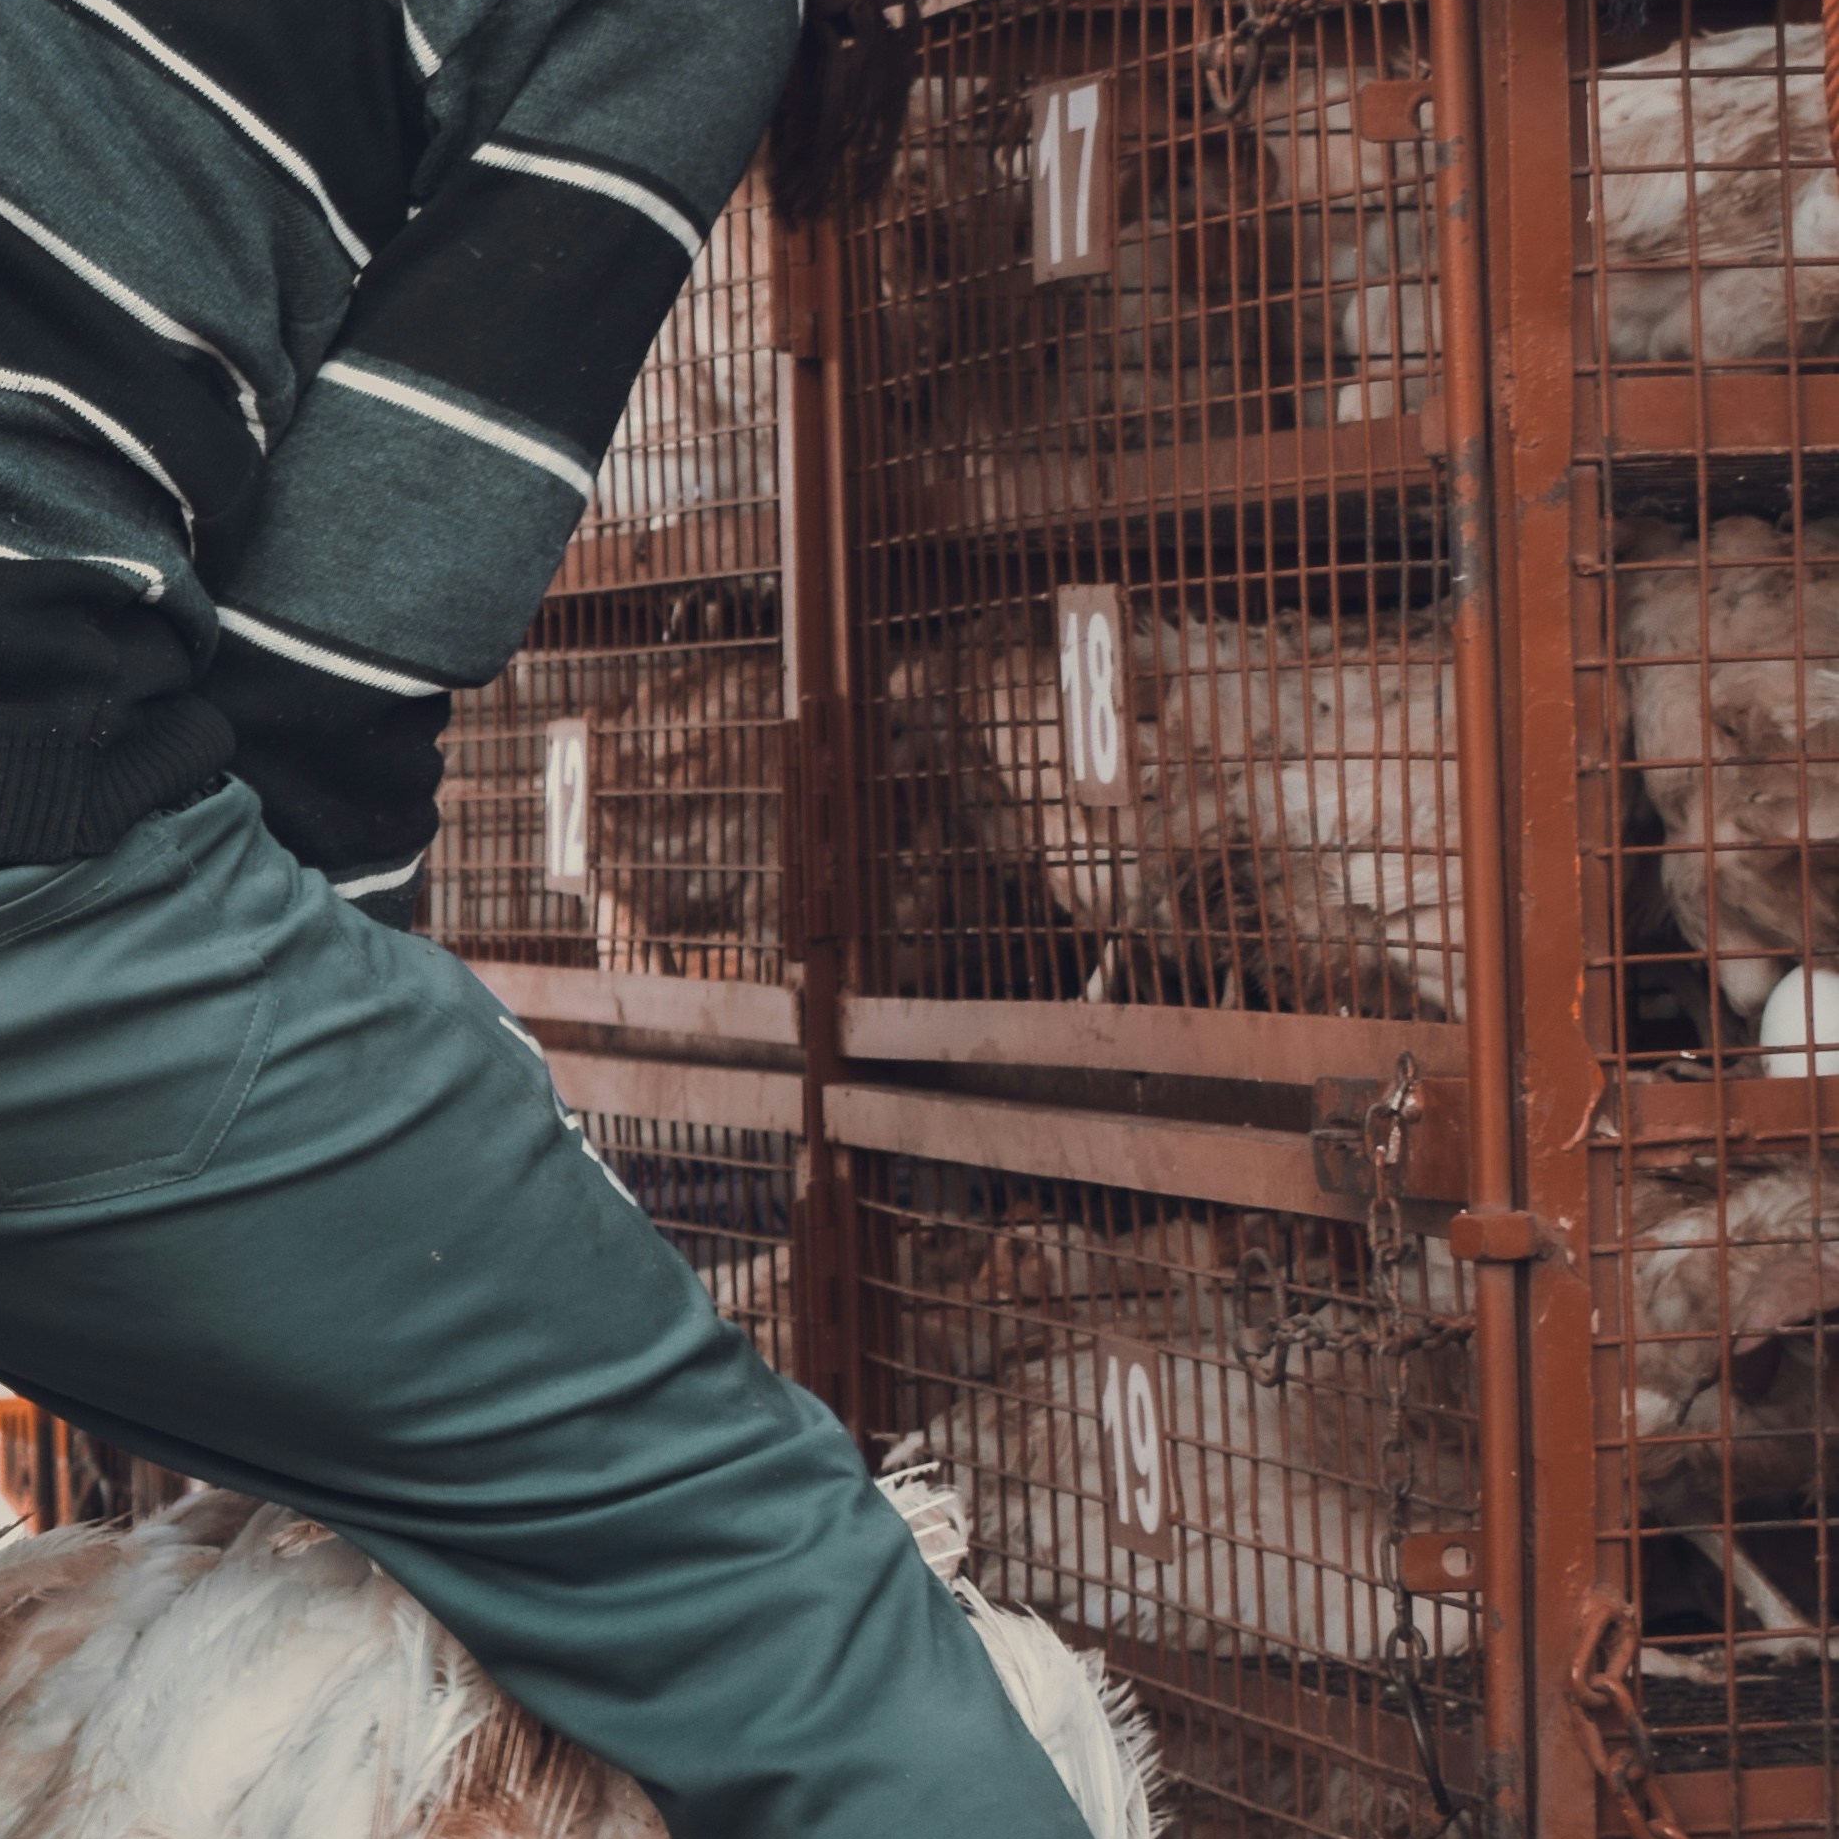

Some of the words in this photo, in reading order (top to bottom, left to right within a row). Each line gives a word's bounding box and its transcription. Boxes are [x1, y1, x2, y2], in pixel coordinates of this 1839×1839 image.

[1039, 82, 1099, 265] 17
[1061, 612, 1118, 785] 18
[545, 737, 585, 877] 12
[1102, 1355, 1161, 1535] 19
